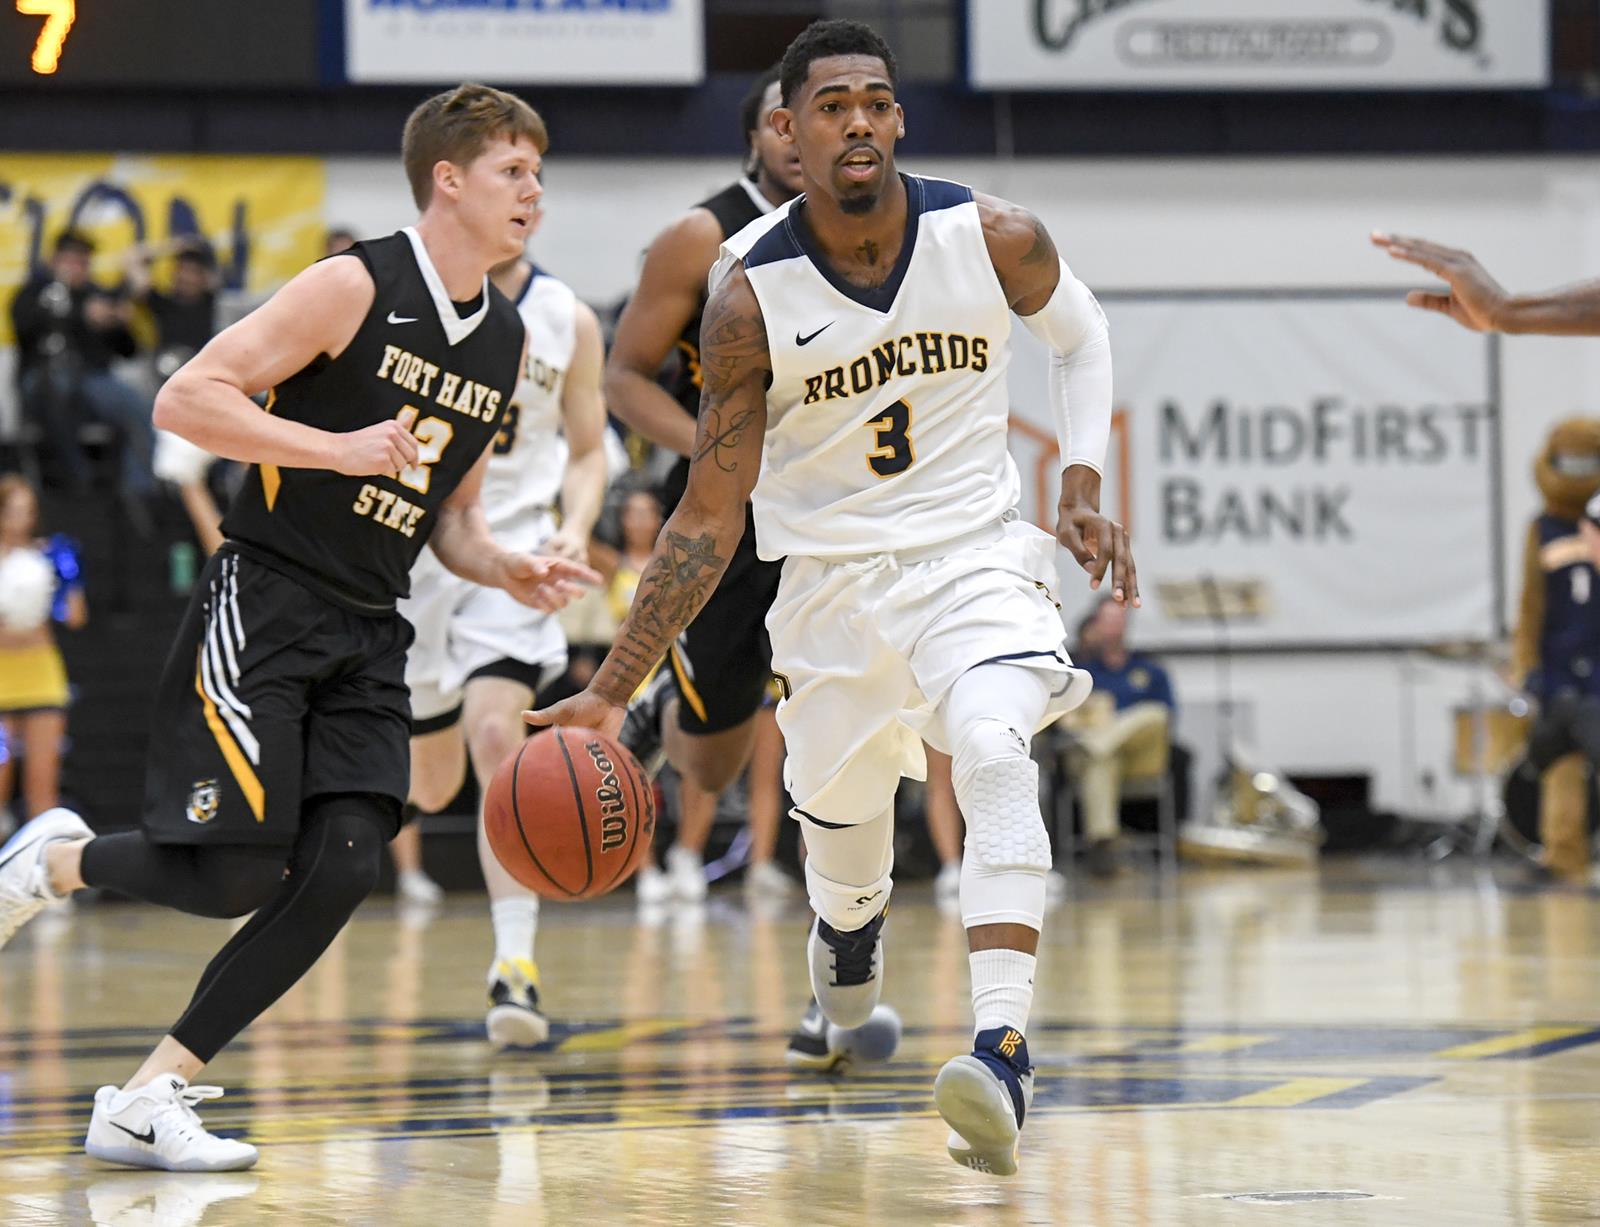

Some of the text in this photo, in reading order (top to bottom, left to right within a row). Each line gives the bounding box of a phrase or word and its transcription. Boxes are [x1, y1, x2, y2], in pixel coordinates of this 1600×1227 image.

[15, 0, 76, 75] 7
[376, 344, 440, 398] FORT
[435, 371, 502, 423] HAYS
[803, 331, 989, 405] BRONCHOS
[863, 397, 916, 479] 3
[1160, 479, 1354, 546] BANK
[584, 739, 632, 854] Wilson
